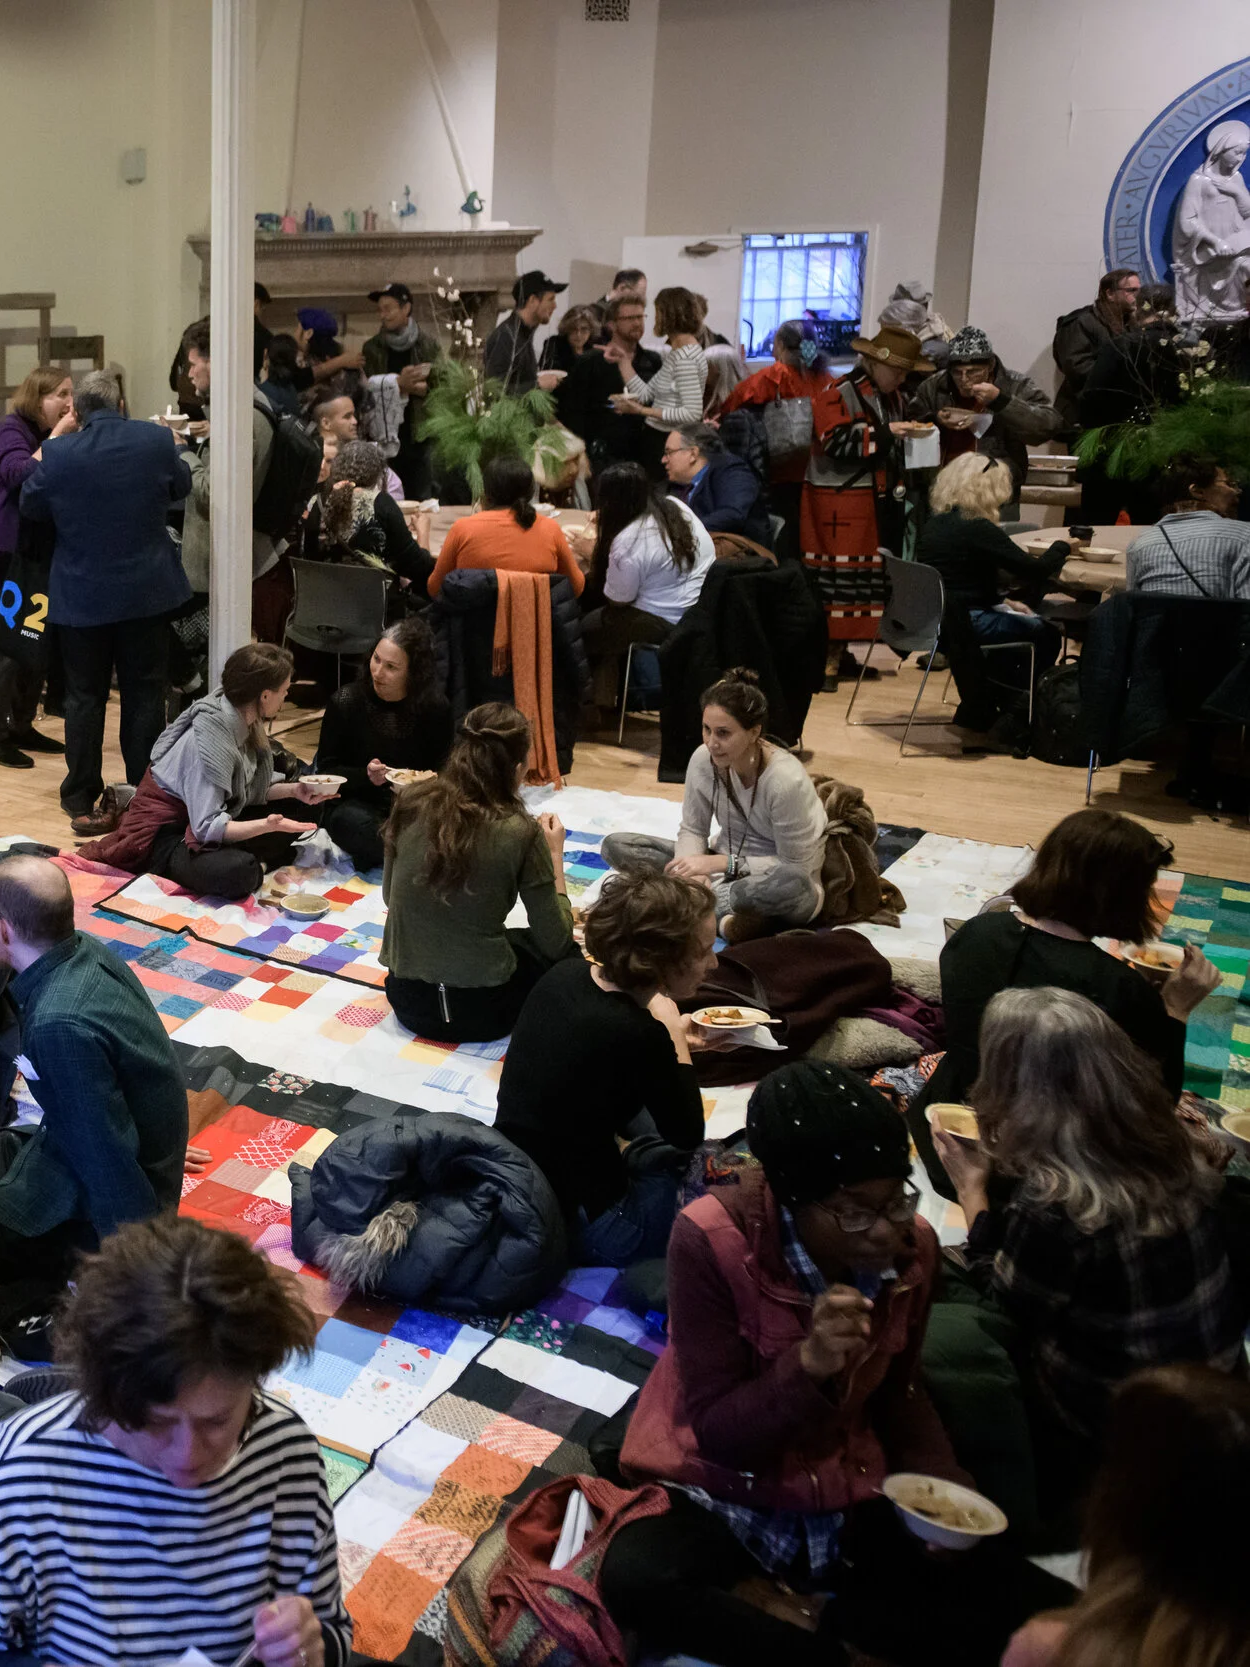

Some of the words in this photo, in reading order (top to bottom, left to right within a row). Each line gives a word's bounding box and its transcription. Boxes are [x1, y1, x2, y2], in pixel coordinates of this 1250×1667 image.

[1124, 84, 1231, 201] AVGVRIVM
[1116, 211, 1142, 272] ATER
[20, 629, 40, 641] MUSIC
